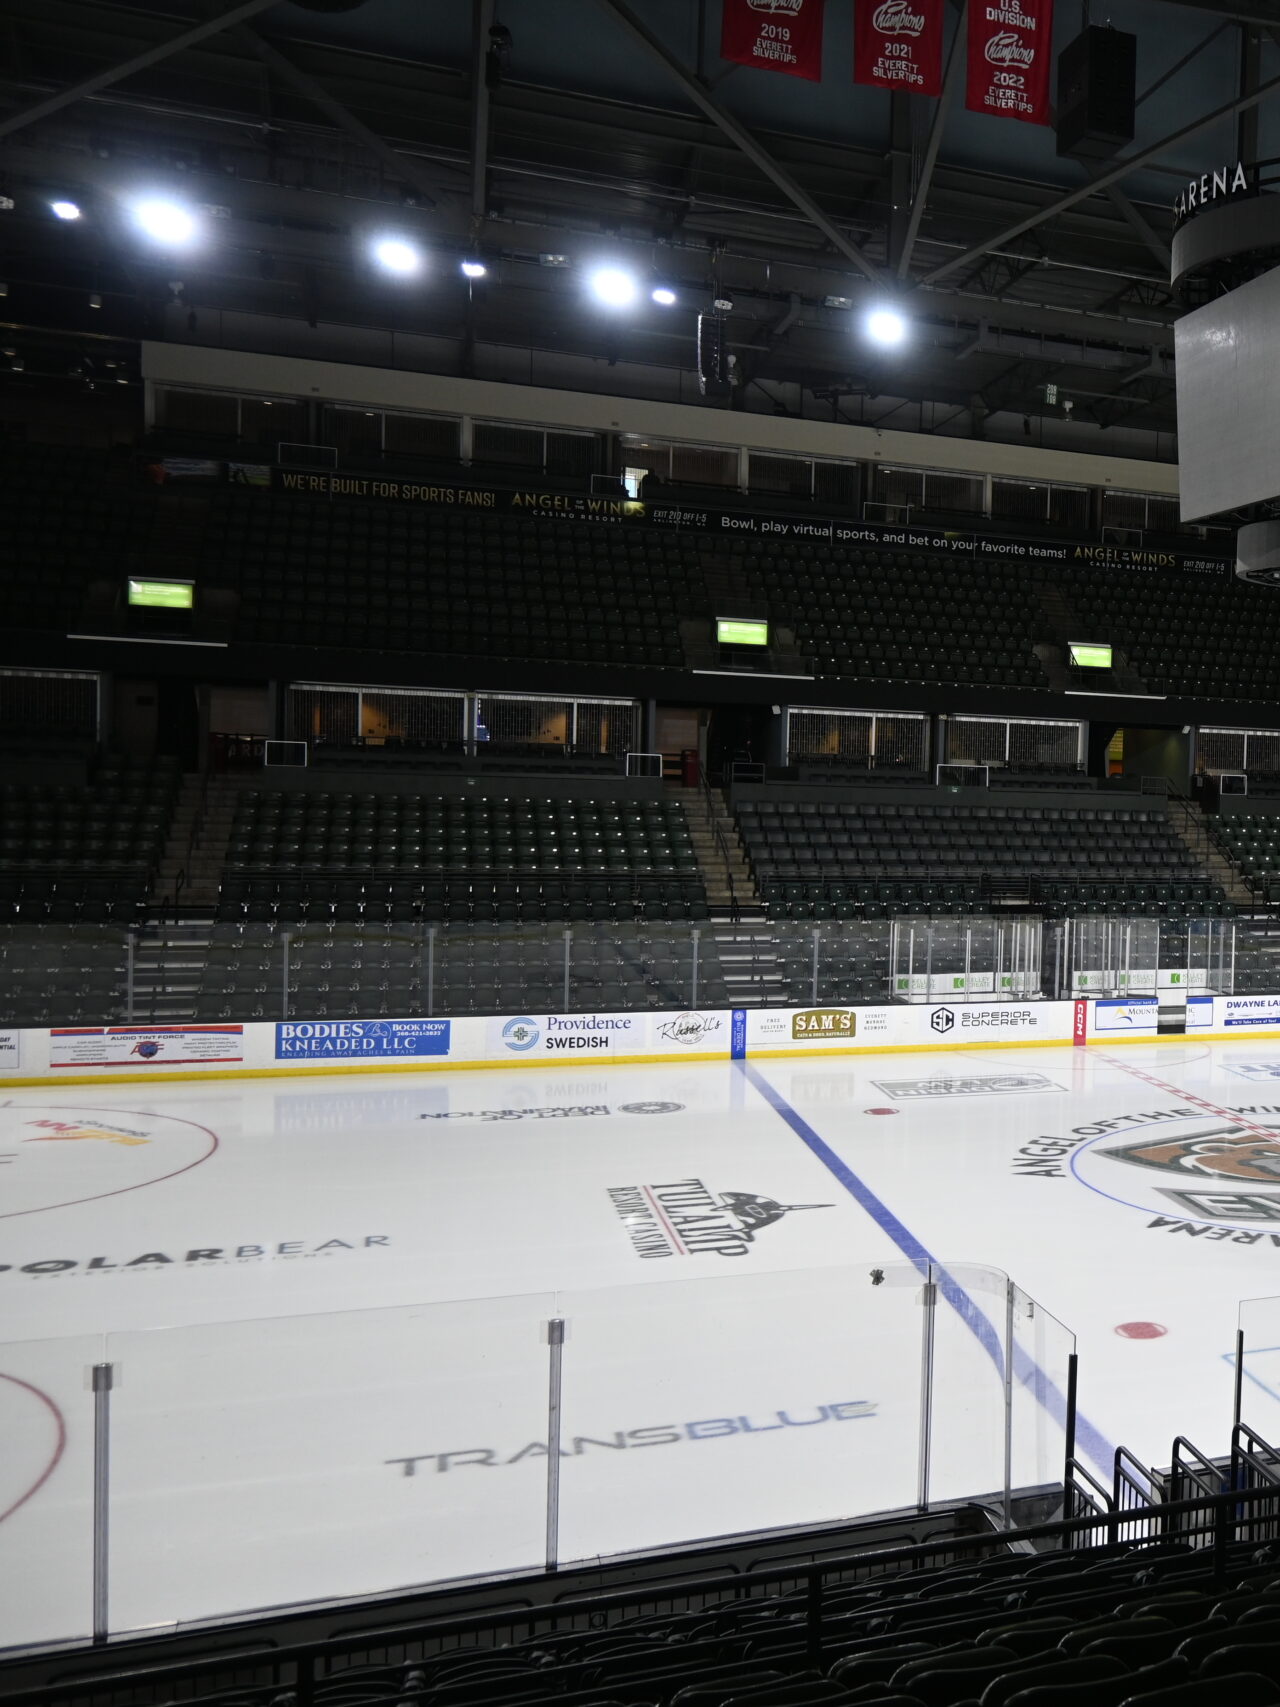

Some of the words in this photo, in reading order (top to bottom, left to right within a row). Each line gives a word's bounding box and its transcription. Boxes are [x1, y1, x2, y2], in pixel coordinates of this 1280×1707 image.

[985, 7, 1036, 31] DIVISION
[761, 23, 790, 41] 2019
[756, 38, 793, 53] EVERETT
[884, 42, 912, 59] 2021
[984, 30, 1035, 69] Champions
[752, 46, 797, 64] SILVERTIPS
[877, 58, 919, 74] EVERETT
[872, 67, 924, 85] SILVERTIPS
[993, 72, 1025, 89] 2022
[989, 87, 1029, 102] EVERETT
[984, 95, 1033, 114] SILVERTIPS
[1179, 161, 1247, 217] ARENA
[282, 472, 328, 492] WE'RE
[330, 478, 369, 496] BUILT
[372, 481, 400, 498] FOR
[402, 484, 455, 503] SPORTS
[458, 488, 495, 507] FANS!
[512, 492, 571, 510] ANGEL
[587, 498, 646, 518] WINDS
[533, 510, 575, 519] CASINO
[580, 514, 623, 523] RESORT
[653, 510, 668, 519] EXIT
[683, 512, 696, 521] OFF
[721, 516, 757, 533] Bowl,
[761, 519, 789, 536] play
[793, 522, 832, 538] virtual
[837, 528, 879, 544] sports,
[882, 530, 905, 544] and
[909, 533, 928, 546] bet
[933, 537, 948, 547] on
[951, 538, 978, 554] your
[981, 539, 1026, 555] favorite
[1029, 544, 1067, 559] teams!
[1074, 545, 1120, 563] ANGEL
[1131, 552, 1176, 568] WINDS
[1089, 561, 1122, 570] CASINO
[1125, 564, 1159, 573] RESORT
[1226, 1000, 1266, 1009] DWAYNE
[547, 1016, 632, 1030] Providence
[795, 1014, 852, 1031] SAM'S
[961, 1010, 1031, 1019] SUPERIOR
[961, 1018, 1038, 1027] CONCRETE
[1075, 1003, 1084, 1036] CCM
[281, 1023, 364, 1039] BODIES
[392, 1023, 421, 1031] BOOK
[422, 1023, 446, 1031] NOW
[281, 1038, 375, 1051] KNEADED
[382, 1037, 417, 1050] LLC
[546, 1036, 609, 1049] SWEDISH
[1011, 1135, 1087, 1178] ANGEL
[1071, 1122, 1118, 1136] OF
[1113, 1108, 1203, 1123] THE
[606, 1185, 654, 1220] RESORT
[650, 1178, 750, 1257] TULALIP
[624, 1221, 675, 1259] CASINO
[31, 1265, 165, 1280] EXTERIOR
[186, 1252, 335, 1267] SOLUTIONS
[384, 1399, 880, 1478] TRANSBLUE
